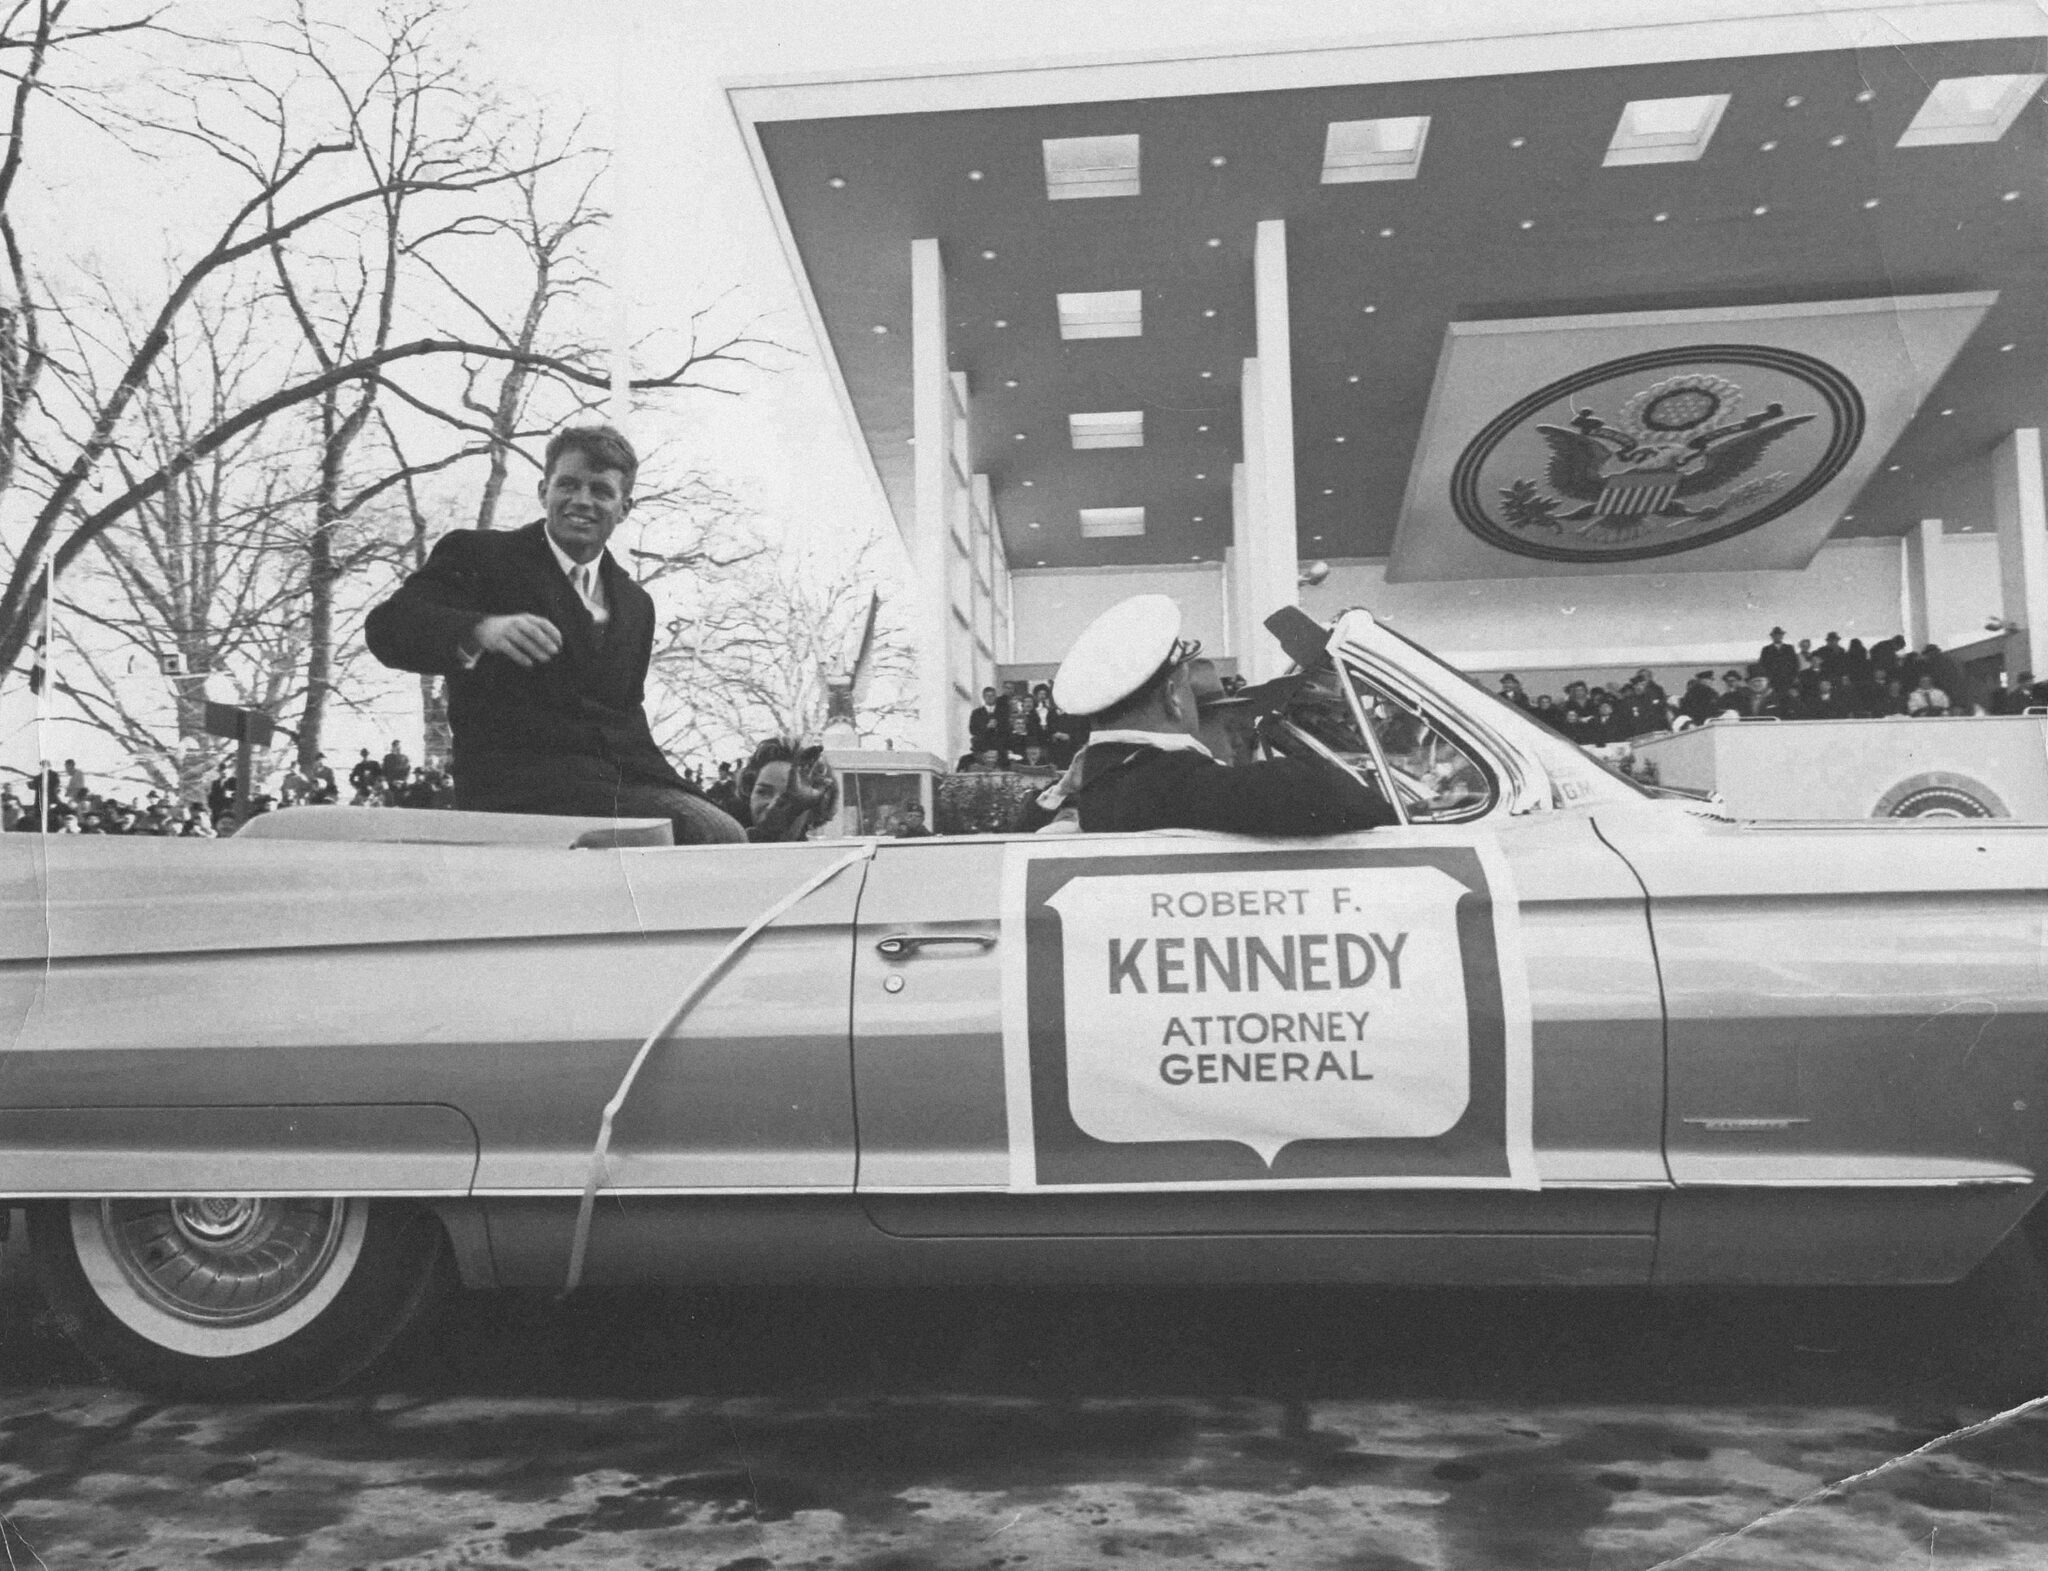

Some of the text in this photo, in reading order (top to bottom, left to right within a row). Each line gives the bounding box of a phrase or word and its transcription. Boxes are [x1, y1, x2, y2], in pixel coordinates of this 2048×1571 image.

[1151, 887, 1362, 918] ROBERT F.
[1108, 932, 1409, 994] KENNEDY
[1161, 1011, 1370, 1046] ATTORNEY
[1159, 1050, 1374, 1085] GENERAL
